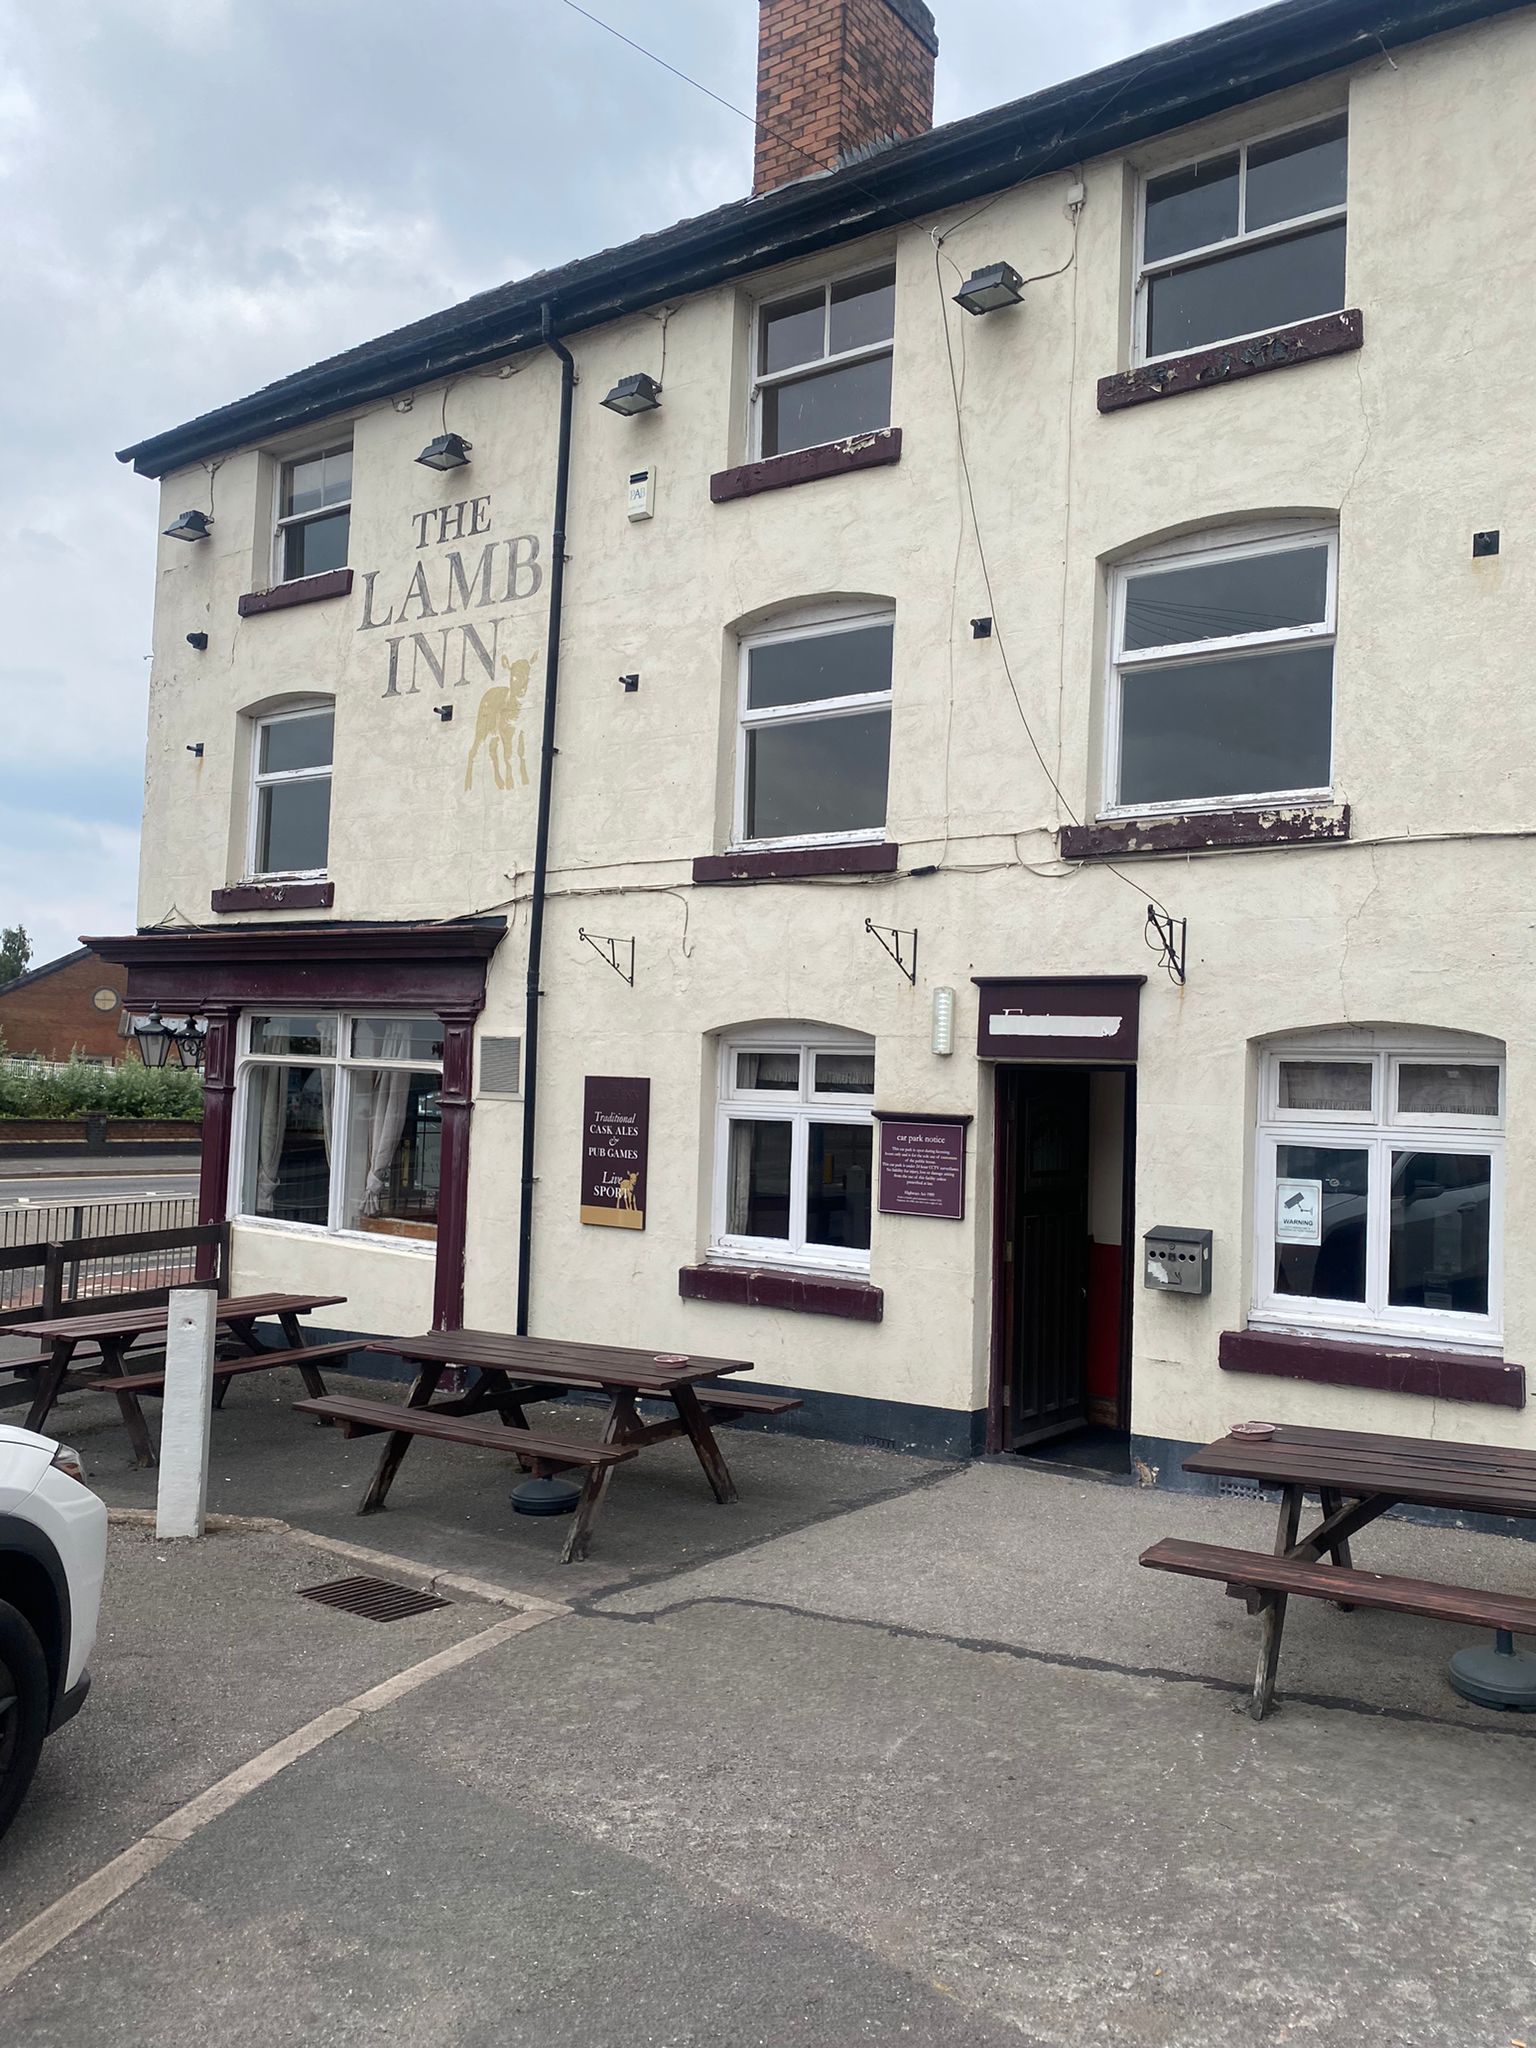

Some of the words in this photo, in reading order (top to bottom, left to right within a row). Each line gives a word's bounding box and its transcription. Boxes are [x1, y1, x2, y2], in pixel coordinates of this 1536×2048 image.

[412, 495, 491, 549] THE
[356, 533, 543, 632] LAMB
[381, 617, 504, 699] INN
[594, 1111, 636, 1124] Traditional
[590, 1124, 612, 1135] CASK
[615, 1126, 638, 1136] ALES
[608, 1136, 620, 1146] &
[909, 1134, 923, 1144] park
[588, 1147, 606, 1158] PUB
[607, 1148, 638, 1160] GAMES
[602, 1171, 622, 1184] Live
[594, 1186, 628, 1198] SPORT
[1283, 1218, 1314, 1226] WARNING
